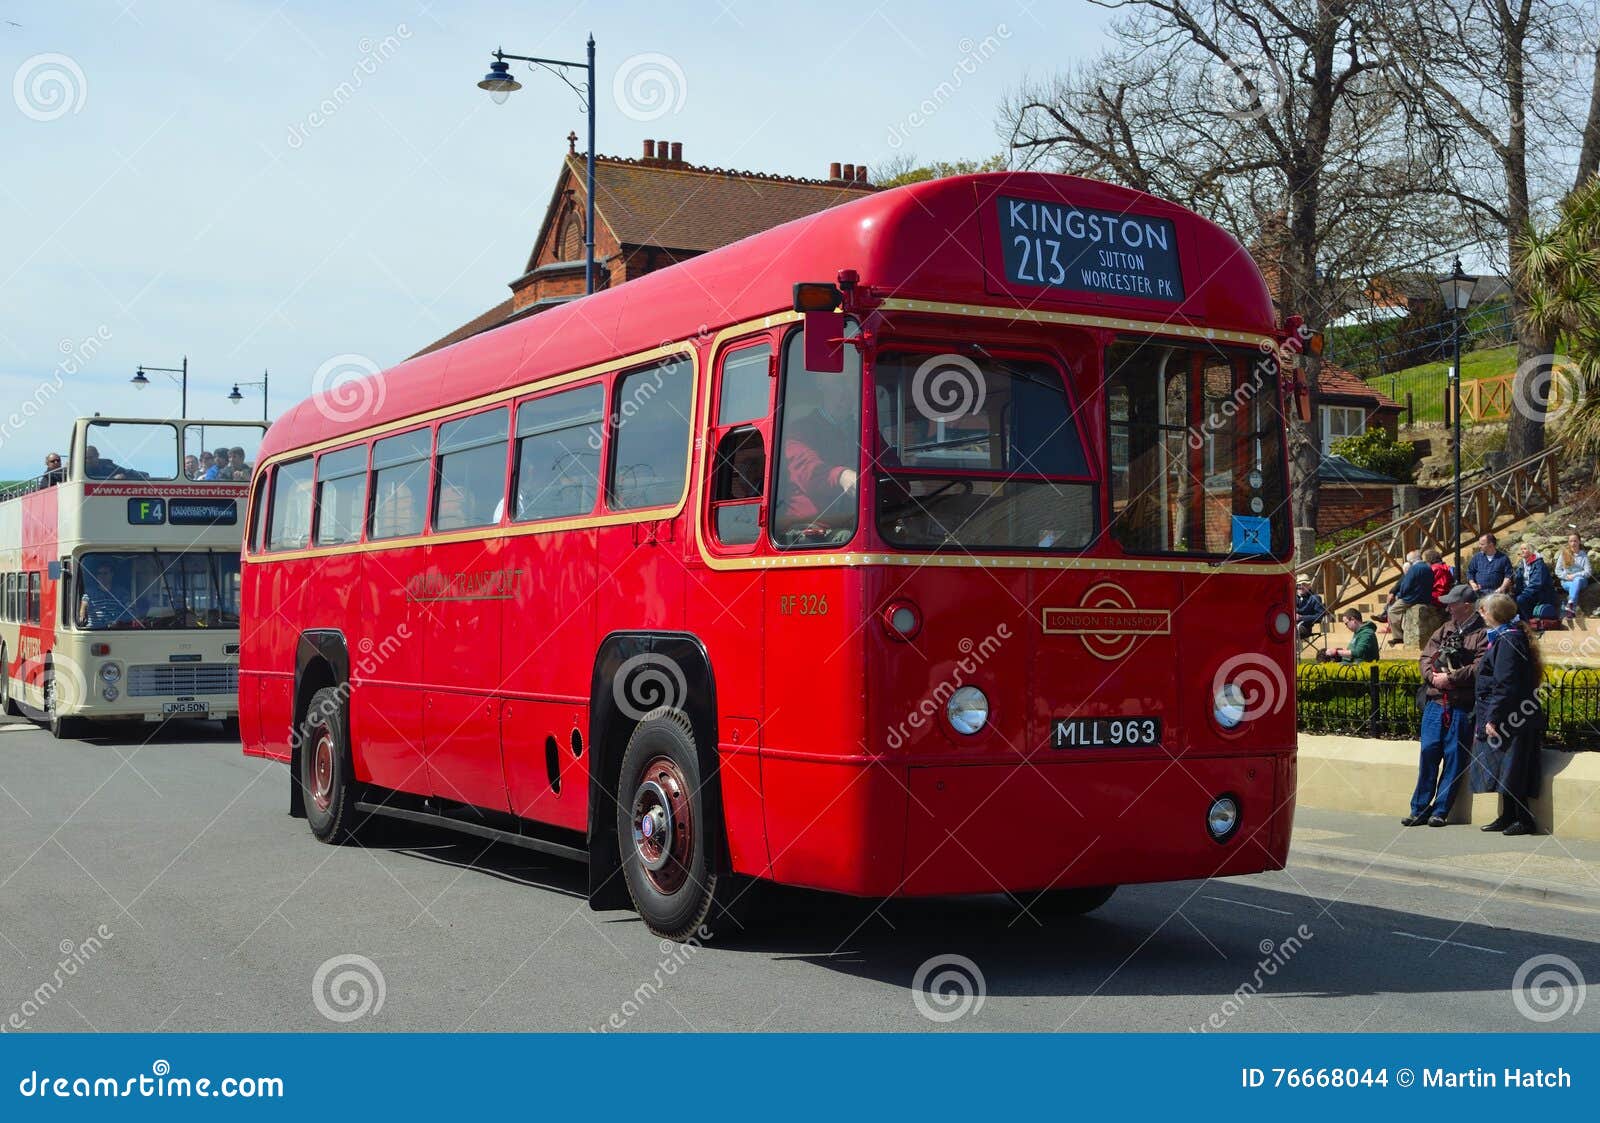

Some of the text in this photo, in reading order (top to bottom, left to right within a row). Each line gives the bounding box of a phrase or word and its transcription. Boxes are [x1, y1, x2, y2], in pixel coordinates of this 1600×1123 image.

[1009, 201, 1168, 250] KINGSTON
[1014, 235, 1065, 285] 213
[1099, 250, 1144, 271] SUTTON
[1081, 269, 1173, 297] WORCESTER PK
[406, 569, 523, 602] LONDON TRANSPORT
[781, 594, 828, 615] RF 326
[1052, 615, 1162, 627] LONDON TRANSPORT
[1057, 720, 1155, 746] MLL 963
